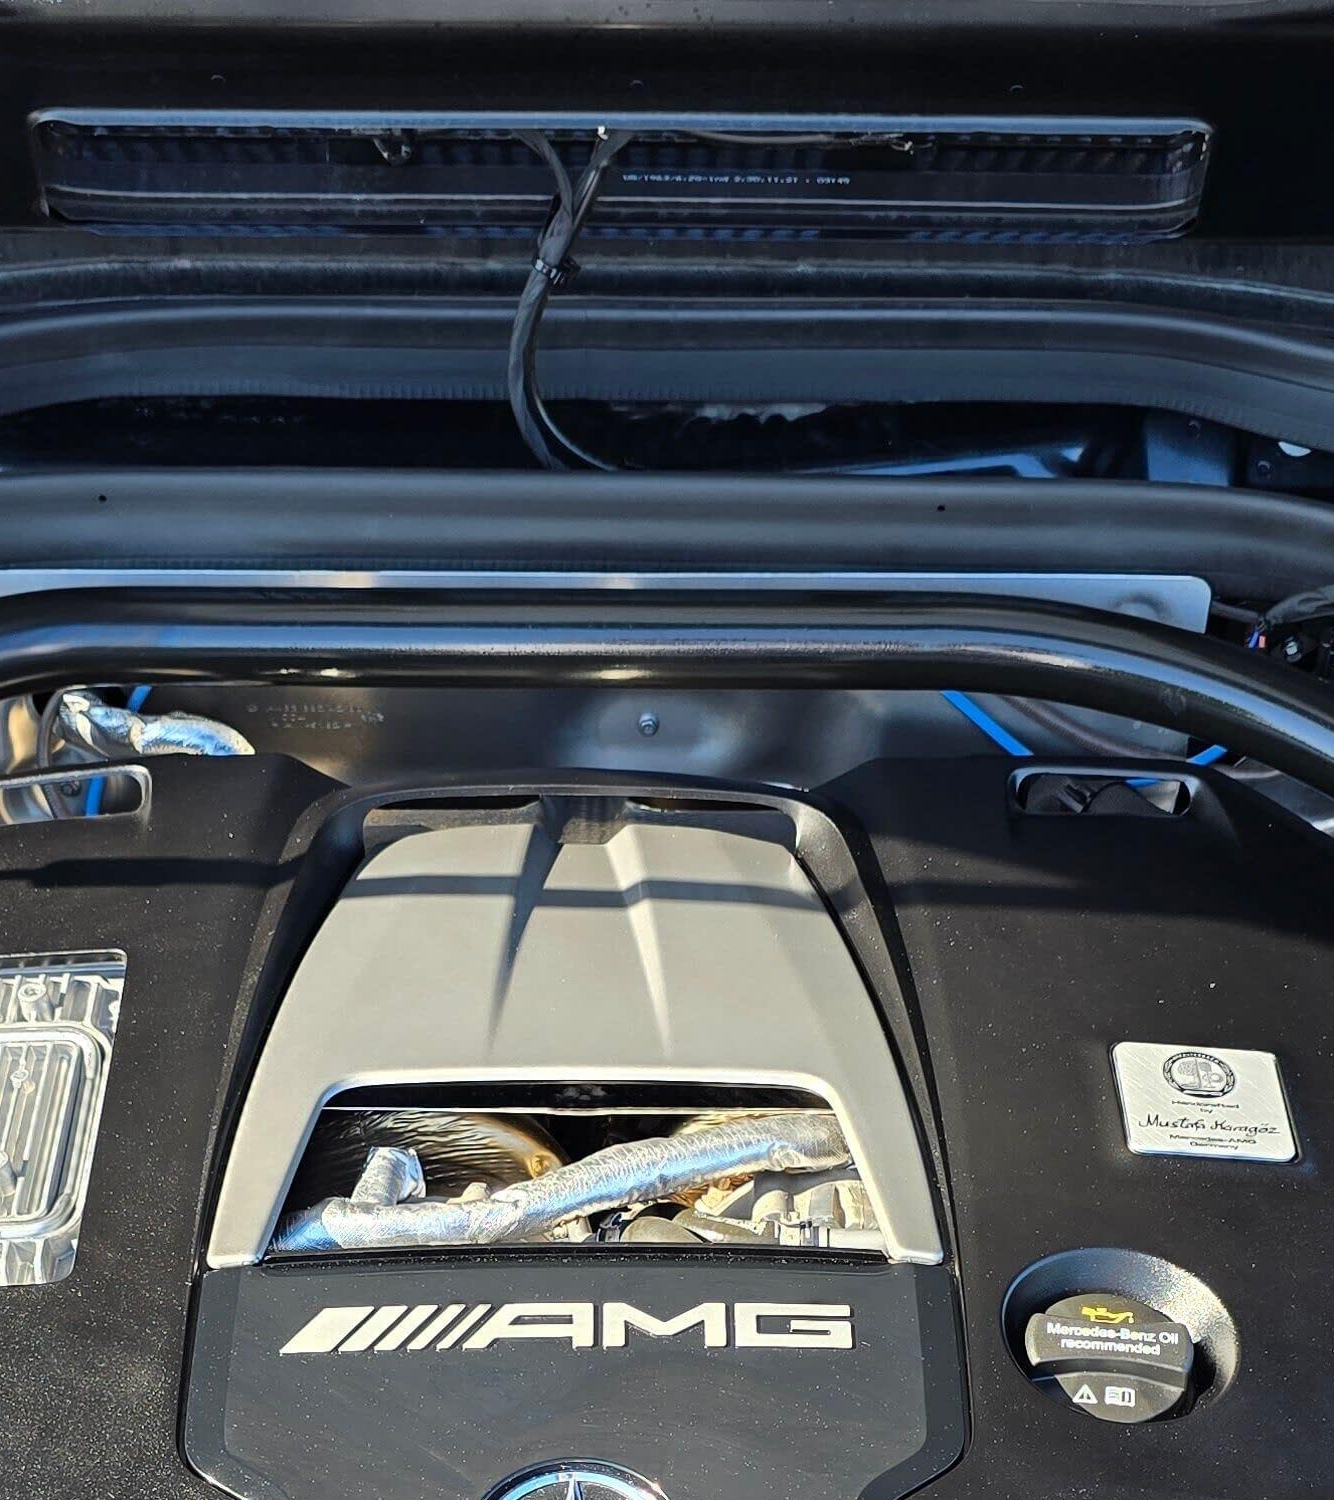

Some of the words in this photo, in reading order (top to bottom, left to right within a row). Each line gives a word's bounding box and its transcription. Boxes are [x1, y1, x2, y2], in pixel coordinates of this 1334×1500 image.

[1169, 1134, 1258, 1146] Mercedes-AMG
[1046, 1322, 1157, 1343] Mercedes-Benz
[1158, 1331, 1180, 1345] Oil
[1060, 1337, 1162, 1357] recommended
